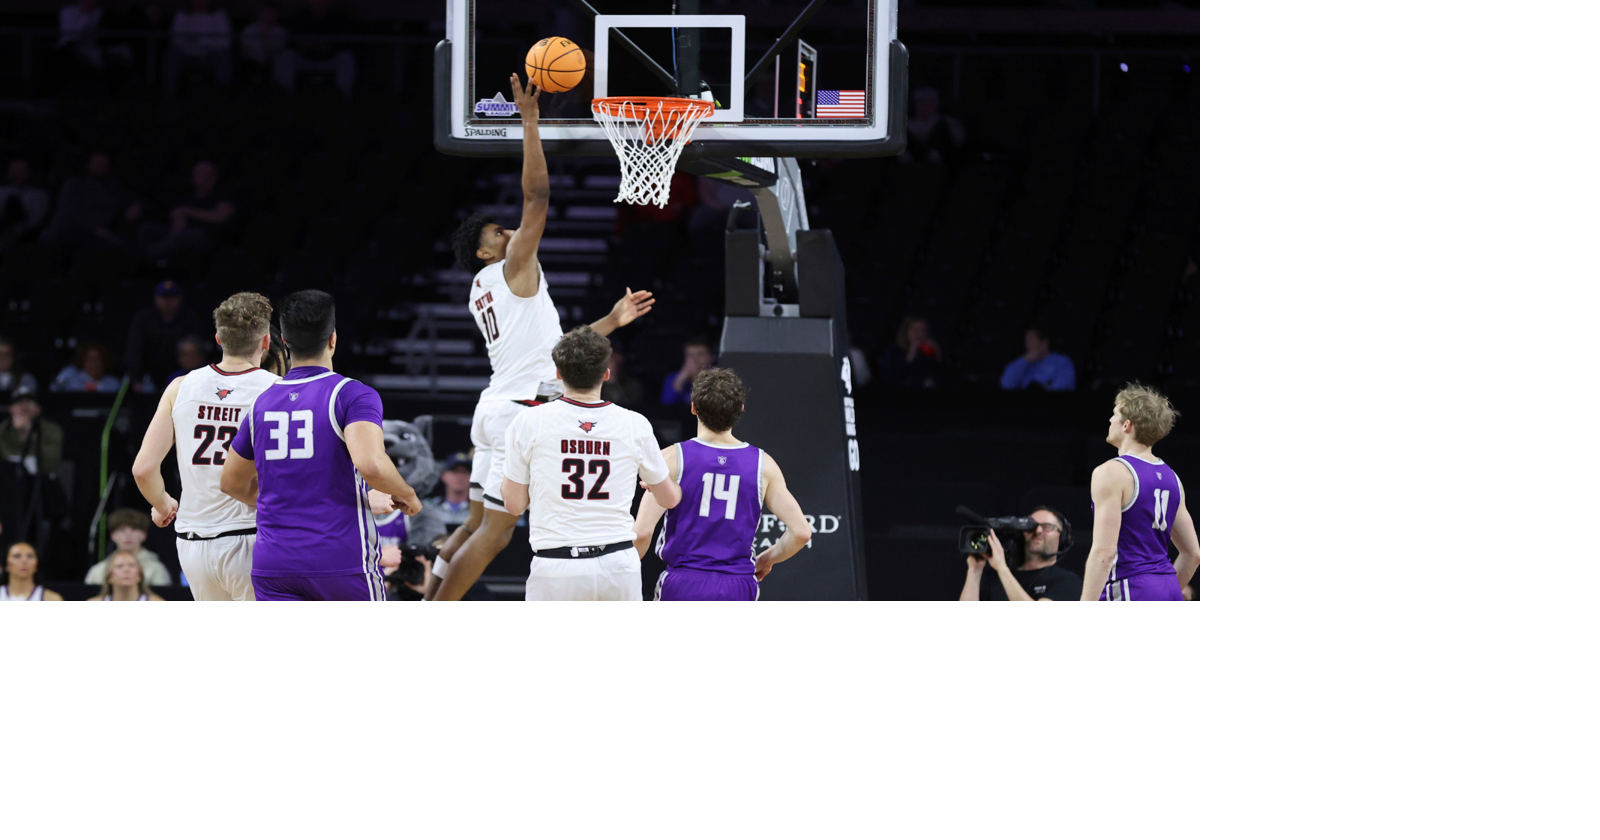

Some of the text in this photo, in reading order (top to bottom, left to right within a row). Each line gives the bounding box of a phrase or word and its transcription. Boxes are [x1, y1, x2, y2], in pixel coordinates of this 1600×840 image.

[476, 103, 520, 112] SUMMIT
[464, 128, 507, 138] SPALDING
[481, 306, 500, 345] 10
[197, 405, 242, 423] STREIT
[192, 424, 239, 466] 23
[263, 409, 315, 461] 33
[560, 439, 611, 456] OSBURN
[561, 458, 611, 501] 32
[698, 472, 741, 520] 14
[1151, 488, 1170, 532] 11
